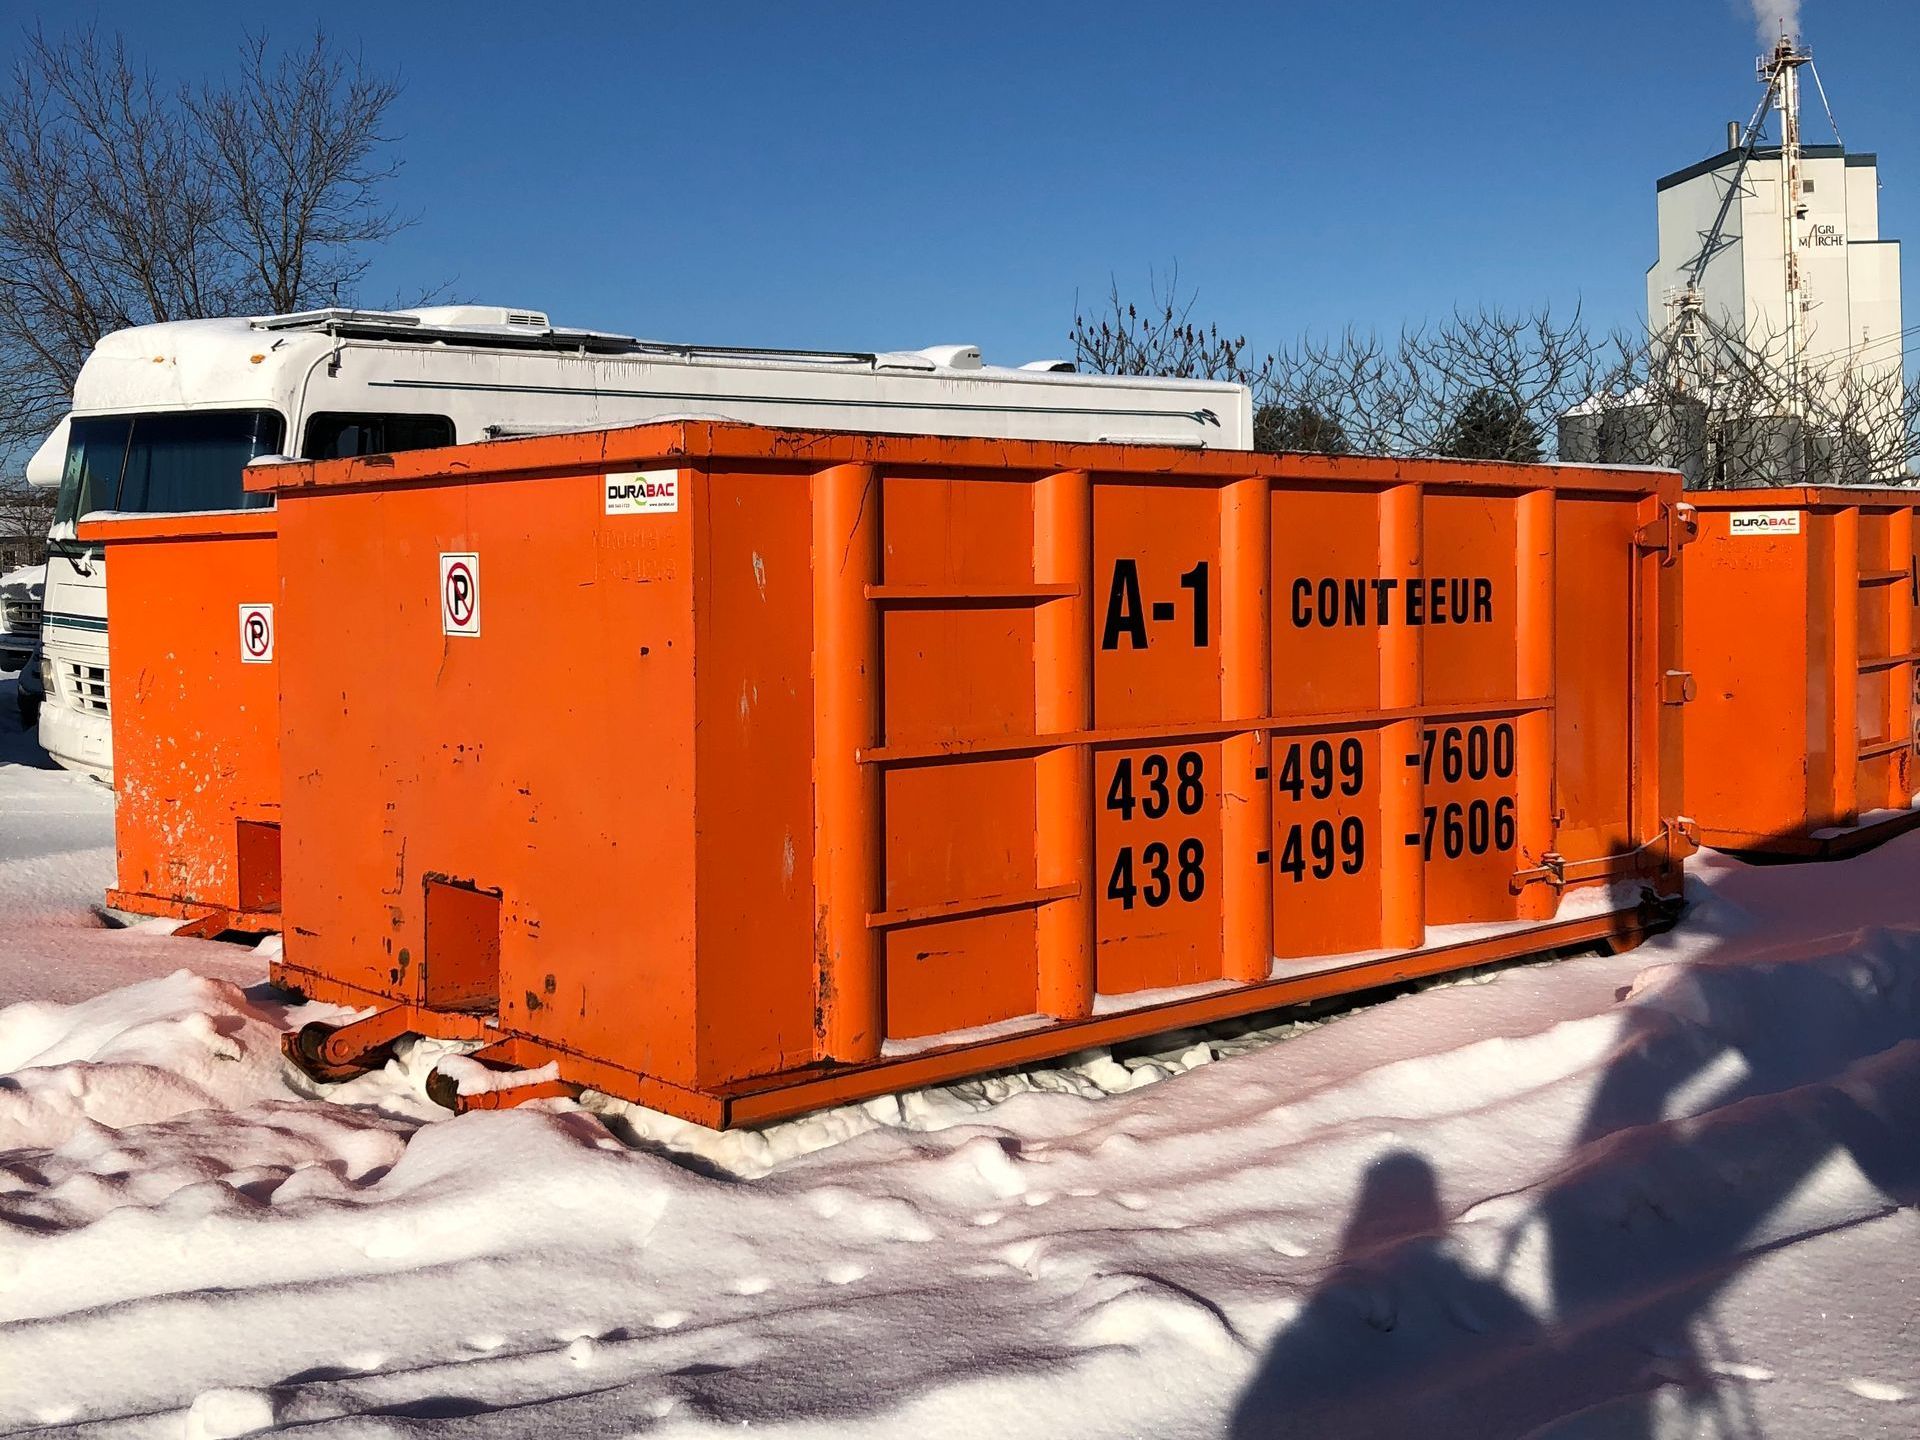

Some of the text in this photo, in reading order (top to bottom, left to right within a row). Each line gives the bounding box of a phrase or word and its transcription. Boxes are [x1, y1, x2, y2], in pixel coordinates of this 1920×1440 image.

[1808, 224, 1834, 236] AGRI
[608, 483, 674, 499] DURABAC
[1733, 518, 1796, 527] DURABAC
[454, 575, 468, 615] P
[1102, 559, 1209, 651] A-1
[251, 620, 264, 649] P
